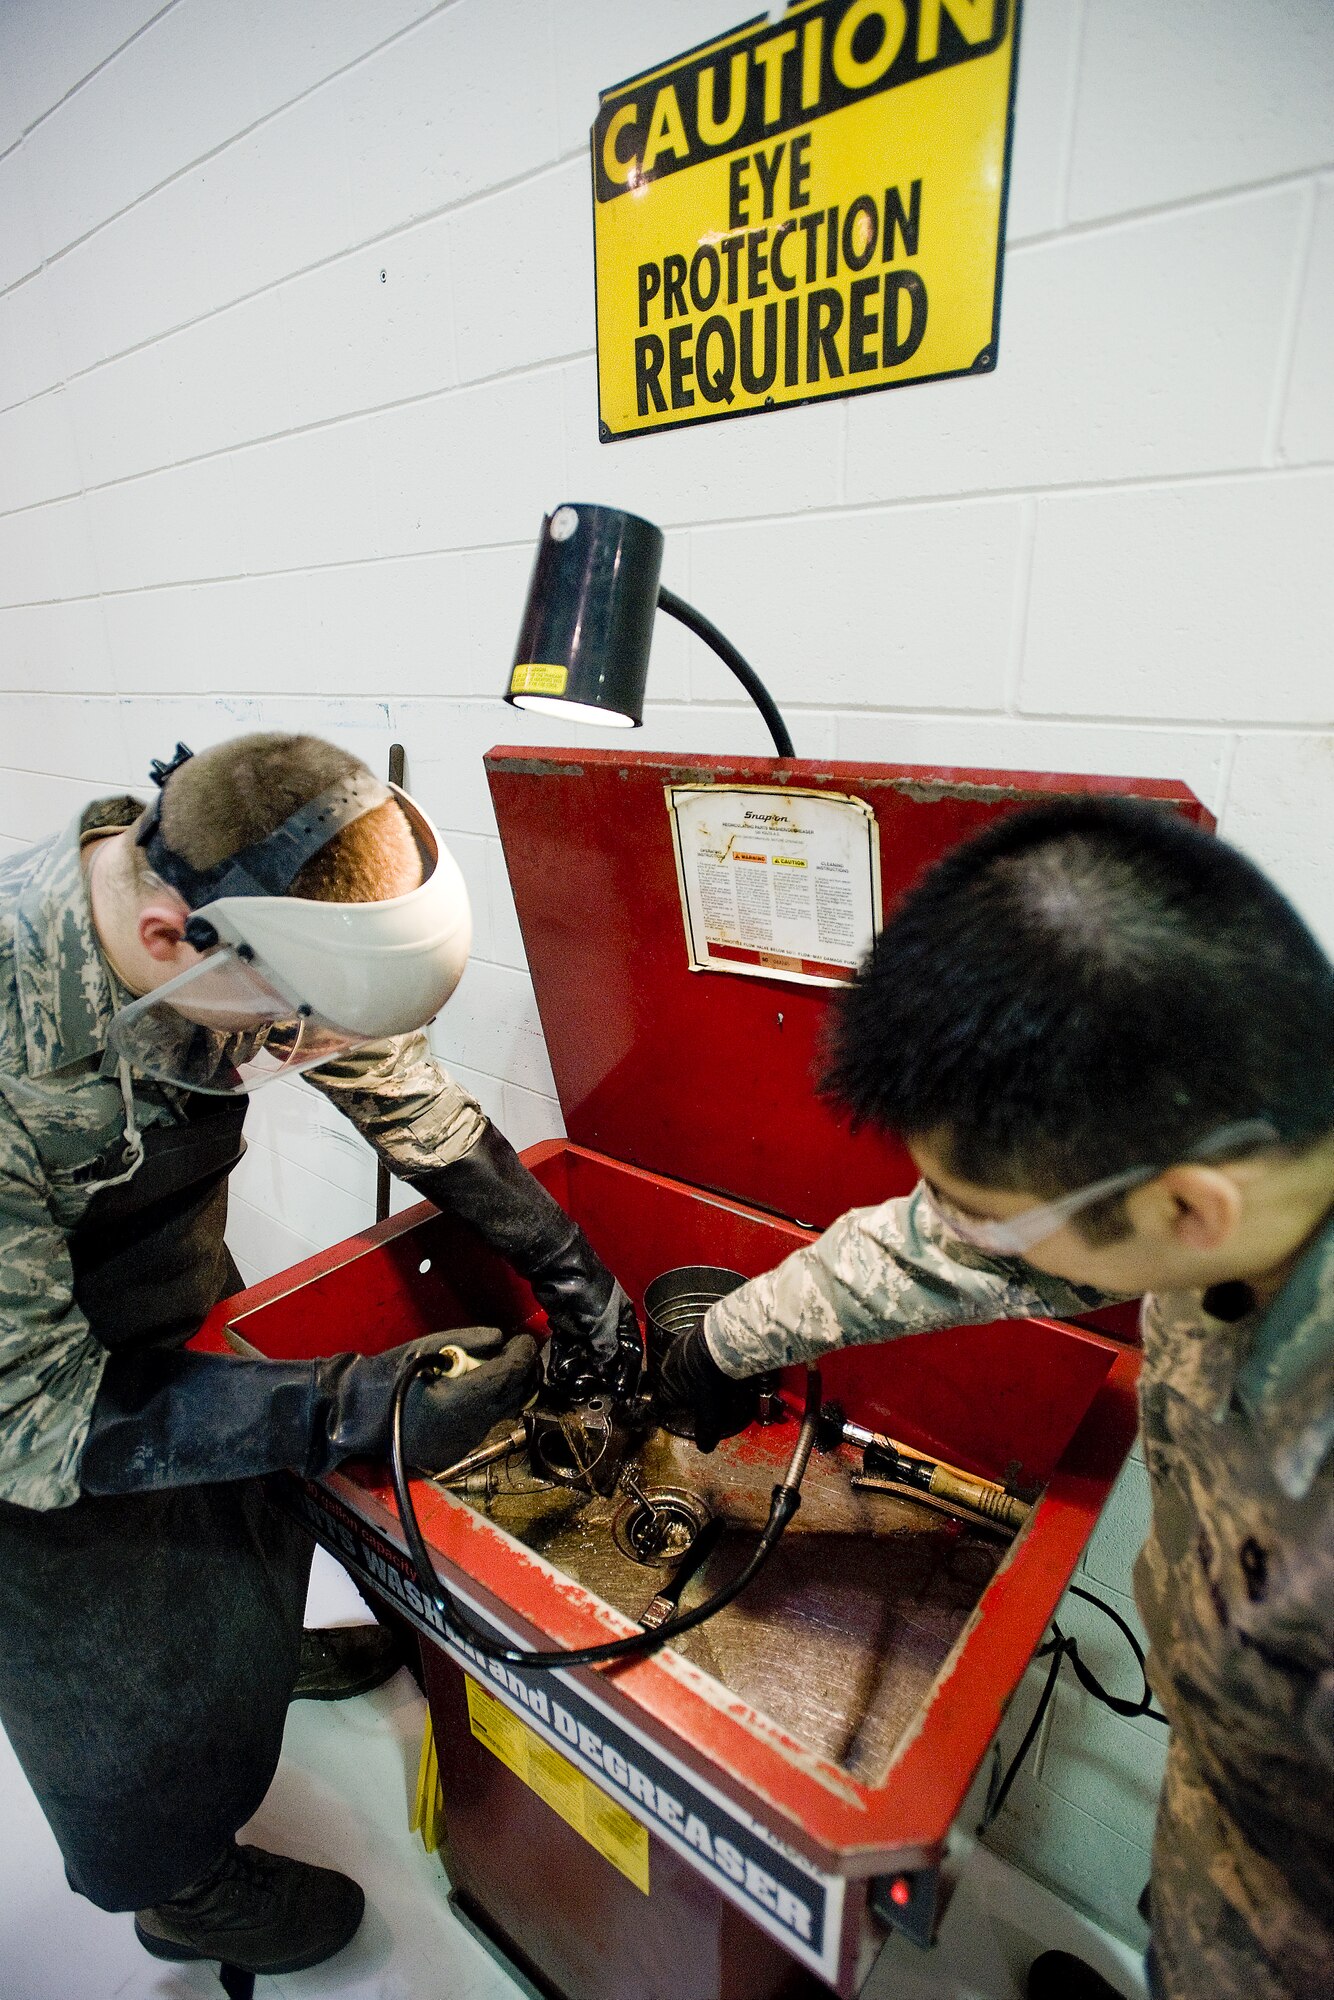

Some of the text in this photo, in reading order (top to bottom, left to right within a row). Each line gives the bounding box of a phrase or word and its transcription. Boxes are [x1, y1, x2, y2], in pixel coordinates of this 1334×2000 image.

[602, 0, 995, 186] CAUTION
[728, 132, 811, 231] EYE
[637, 178, 924, 328] PROTECTION
[634, 269, 929, 417] REQUIRED
[741, 854, 766, 863] WARNING
[780, 858, 806, 867] CAUTION
[321, 1494, 358, 1536] gallon
[361, 1528, 419, 1582] capacity
[490, 1659, 550, 1722] and
[551, 1701, 812, 1940] DEGREASER
